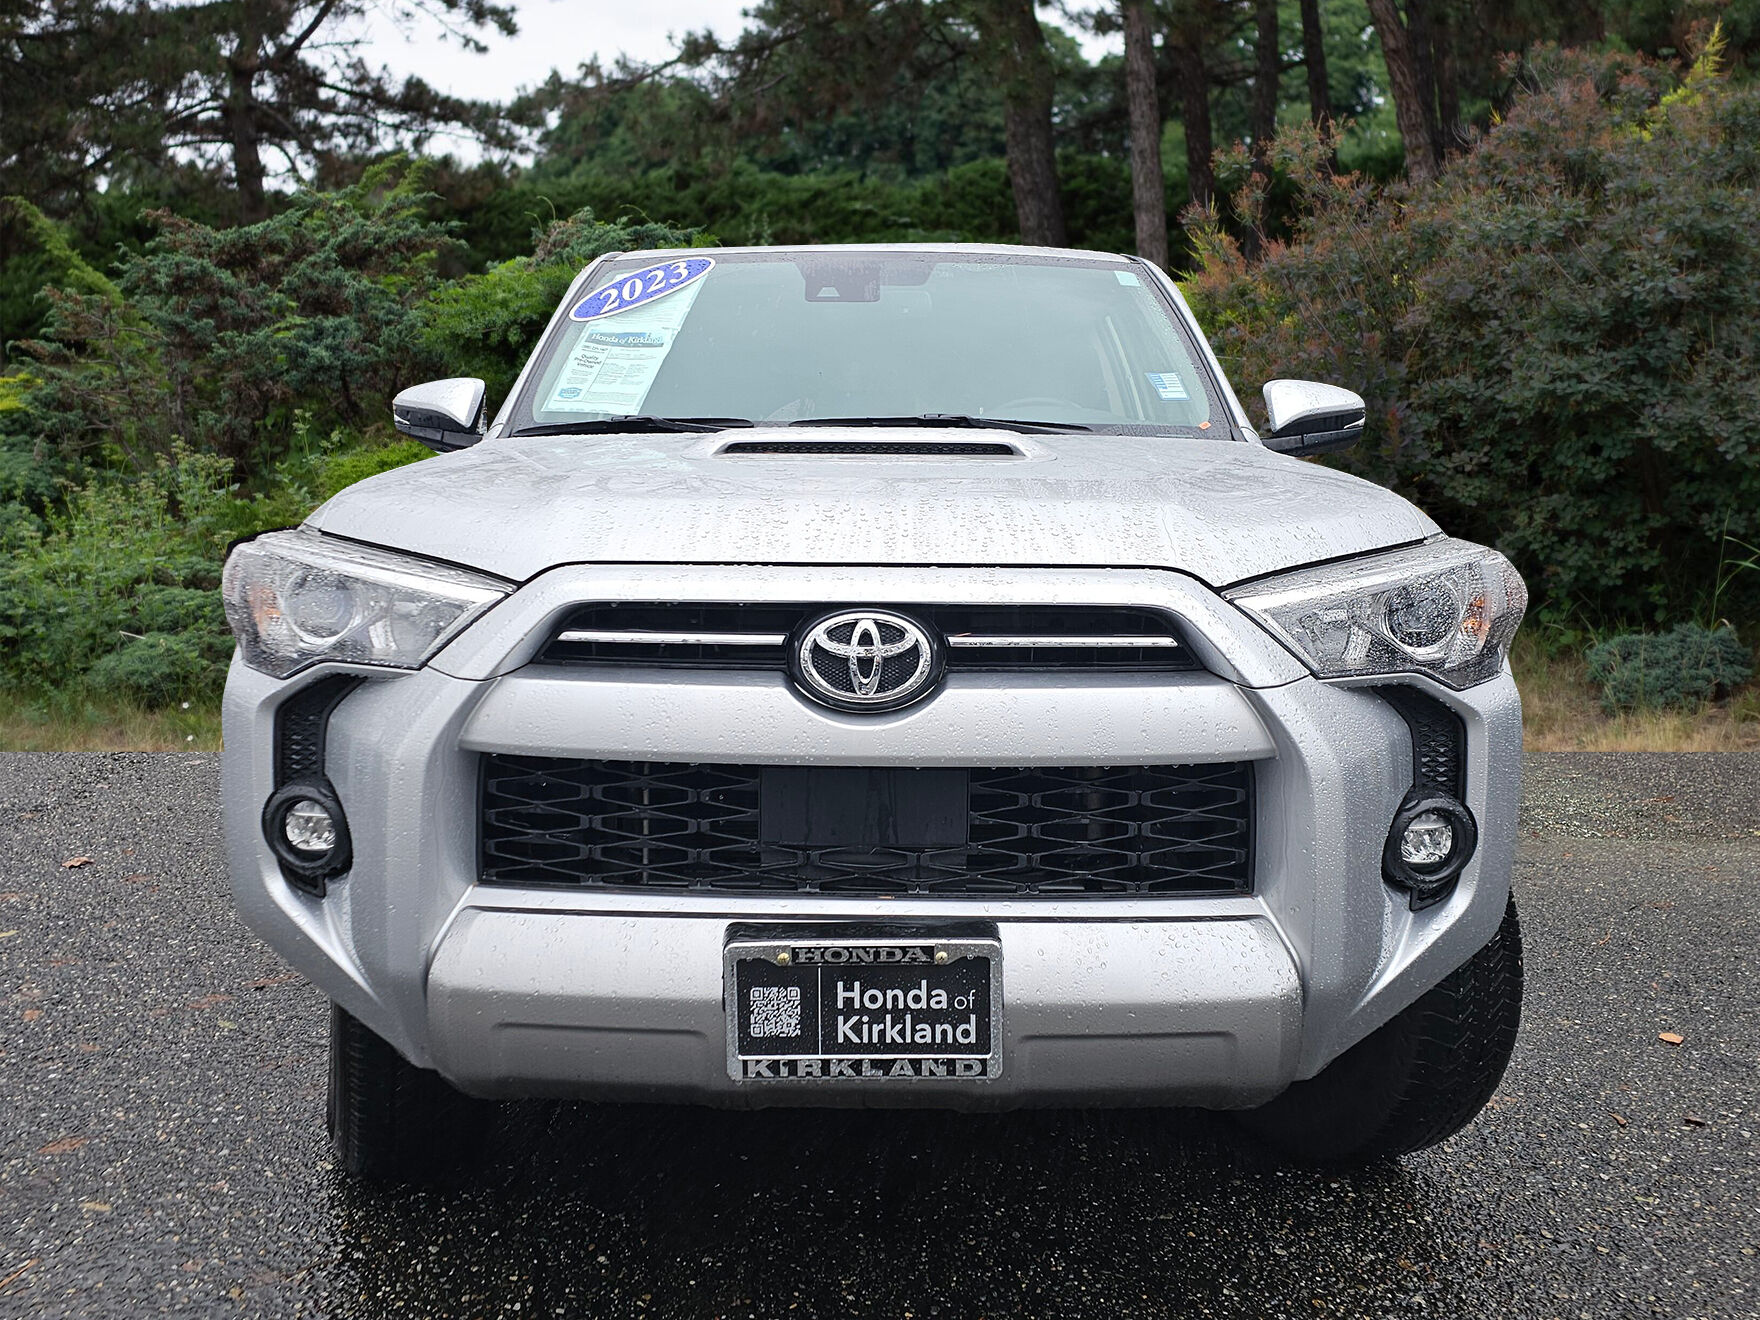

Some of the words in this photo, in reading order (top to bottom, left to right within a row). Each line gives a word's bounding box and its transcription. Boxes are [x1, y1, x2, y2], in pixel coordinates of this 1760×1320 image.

[600, 261, 688, 313] 2023
[592, 333, 618, 343] Honda
[795, 947, 931, 963] HONDA
[837, 980, 948, 1010] Honda
[954, 990, 976, 1010] of
[837, 1014, 977, 1044] Kirkland
[747, 1059, 984, 1078] KIRKLAND
